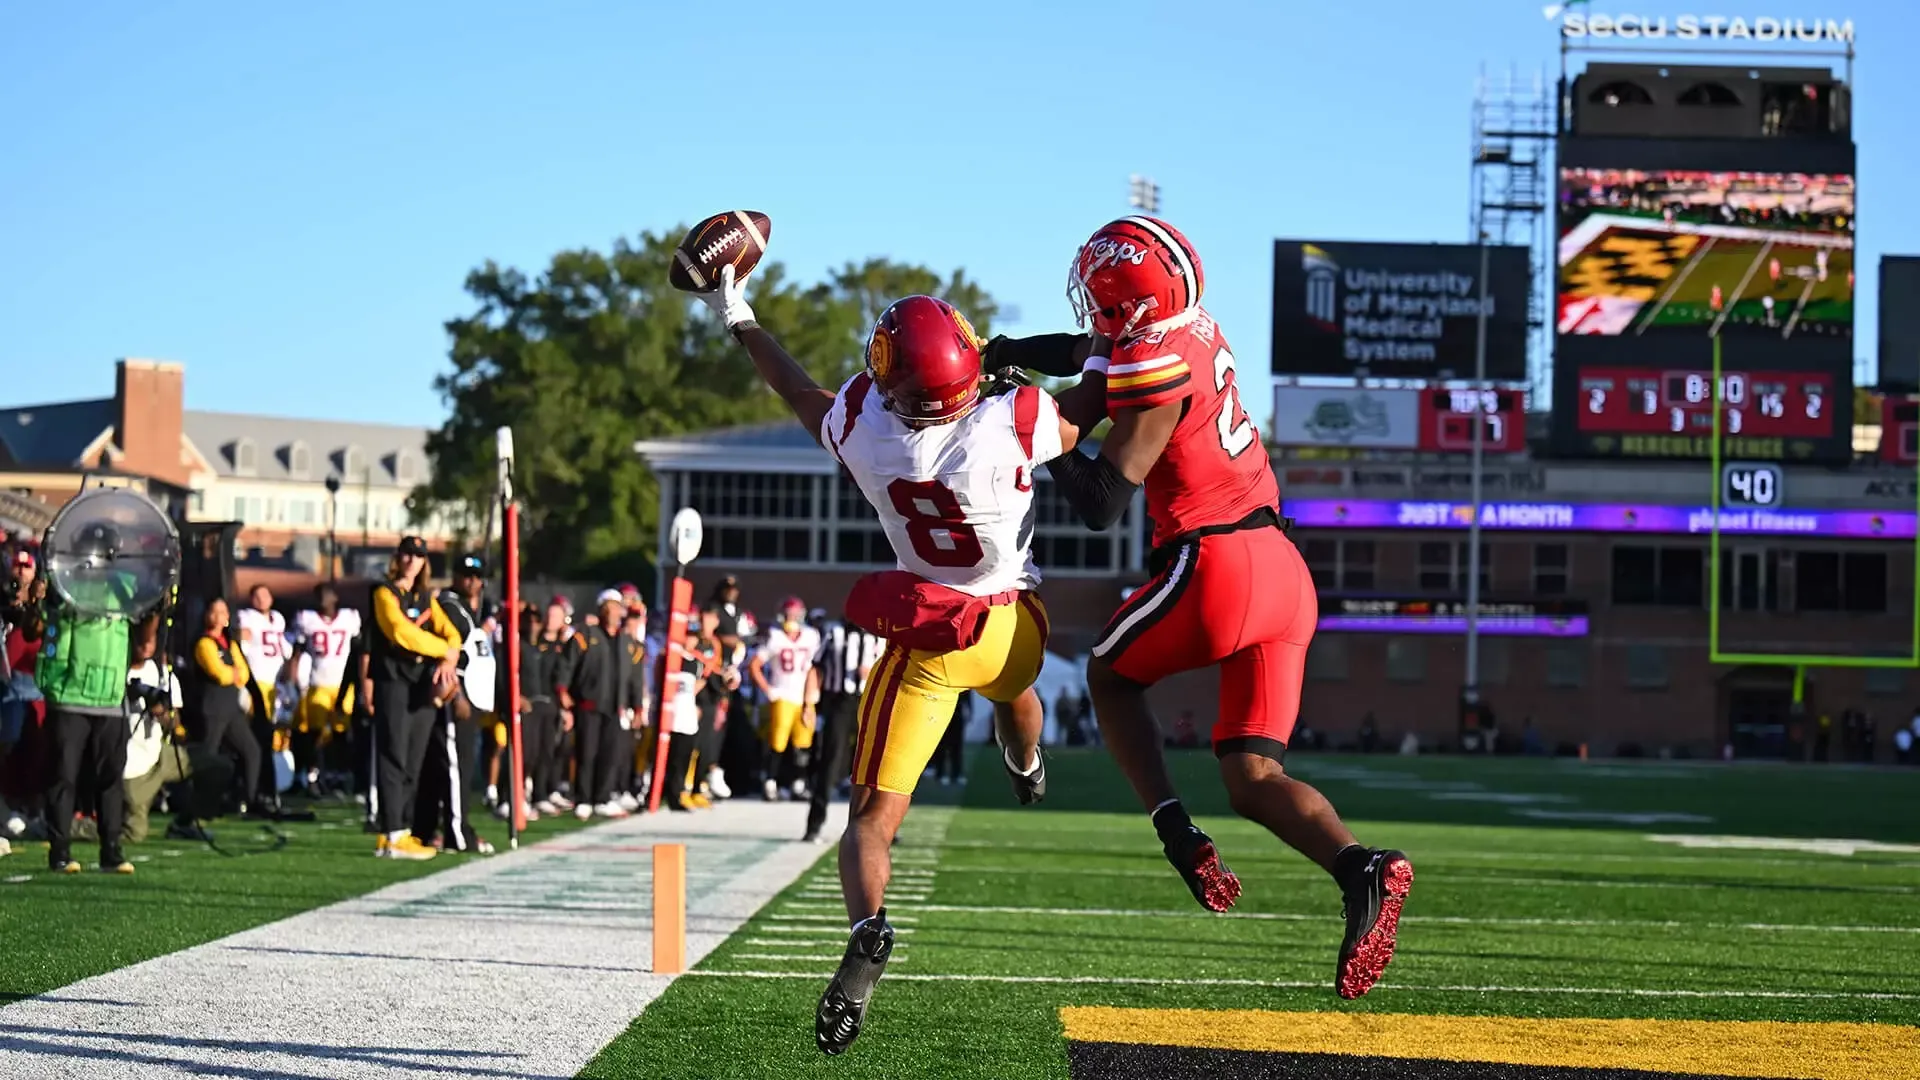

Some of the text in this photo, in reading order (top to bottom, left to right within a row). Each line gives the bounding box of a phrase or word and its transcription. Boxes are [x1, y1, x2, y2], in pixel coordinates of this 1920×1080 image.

[1676, 14, 1854, 43] STADIUM
[1345, 268, 1474, 297] University
[1344, 293, 1495, 318] of Maryland
[1344, 315, 1442, 338] Medical
[1344, 338, 1436, 362] System
[1589, 388, 1606, 414] 2
[1806, 393, 1822, 418] 2
[1486, 415, 1502, 442] 7
[1731, 469, 1774, 504] 40
[887, 477, 984, 567] 8
[1397, 502, 1450, 525] JUST
[1481, 504, 1497, 526] A
[1499, 504, 1574, 527] MONTH
[312, 630, 347, 657] 97
[780, 647, 809, 673] 87
